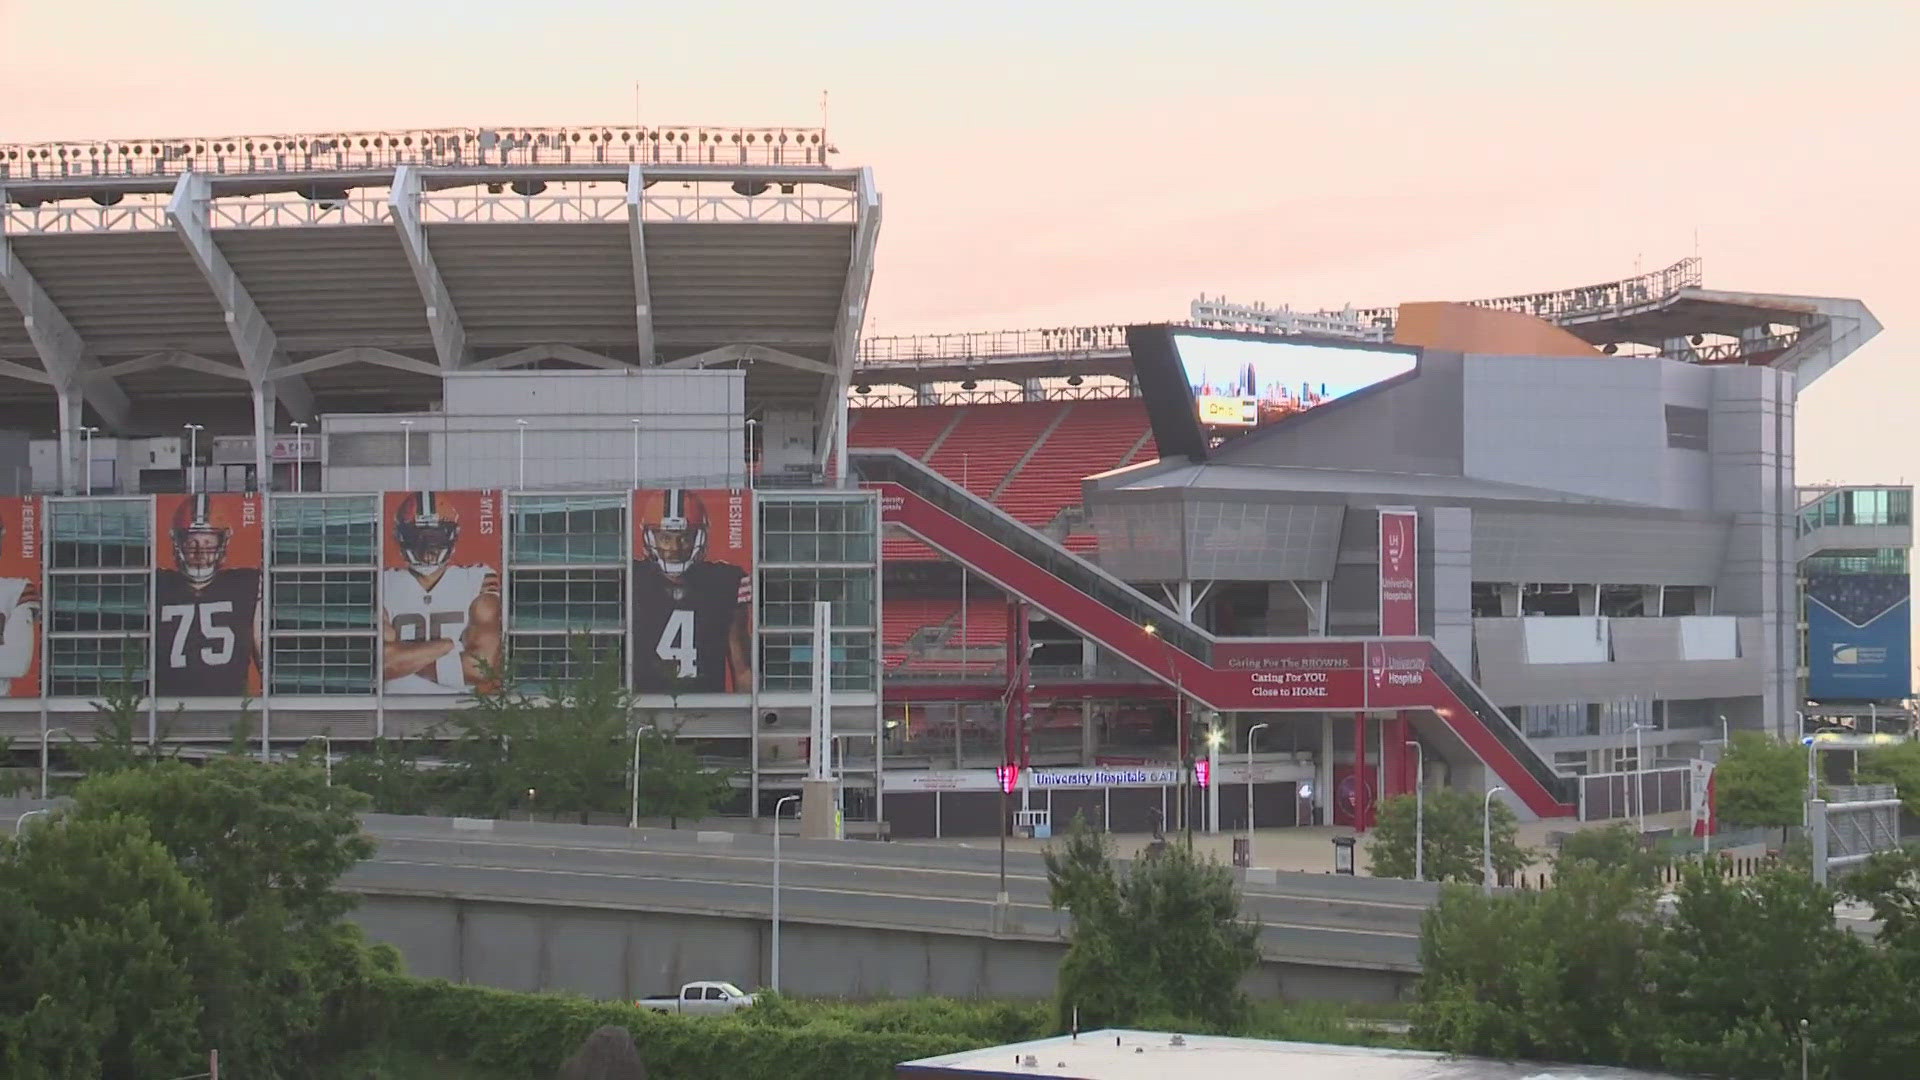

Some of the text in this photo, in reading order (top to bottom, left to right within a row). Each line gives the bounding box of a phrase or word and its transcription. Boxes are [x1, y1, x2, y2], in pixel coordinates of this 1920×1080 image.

[243, 501, 255, 528] JOEL
[480, 499, 493, 534] MYLES
[161, 601, 236, 668] 75
[655, 609, 697, 679] 4
[1228, 658, 1261, 669] Caring
[1264, 659, 1278, 667] For
[1280, 659, 1299, 667] The
[1388, 657, 1425, 672] University
[1251, 673, 1284, 684] Caring
[1285, 674, 1302, 683] For
[1388, 671, 1423, 686] Hospitals
[1251, 687, 1278, 697] Close
[1280, 688, 1290, 697] to
[1036, 772, 1092, 786] University
[1094, 769, 1146, 785] Hospitals
